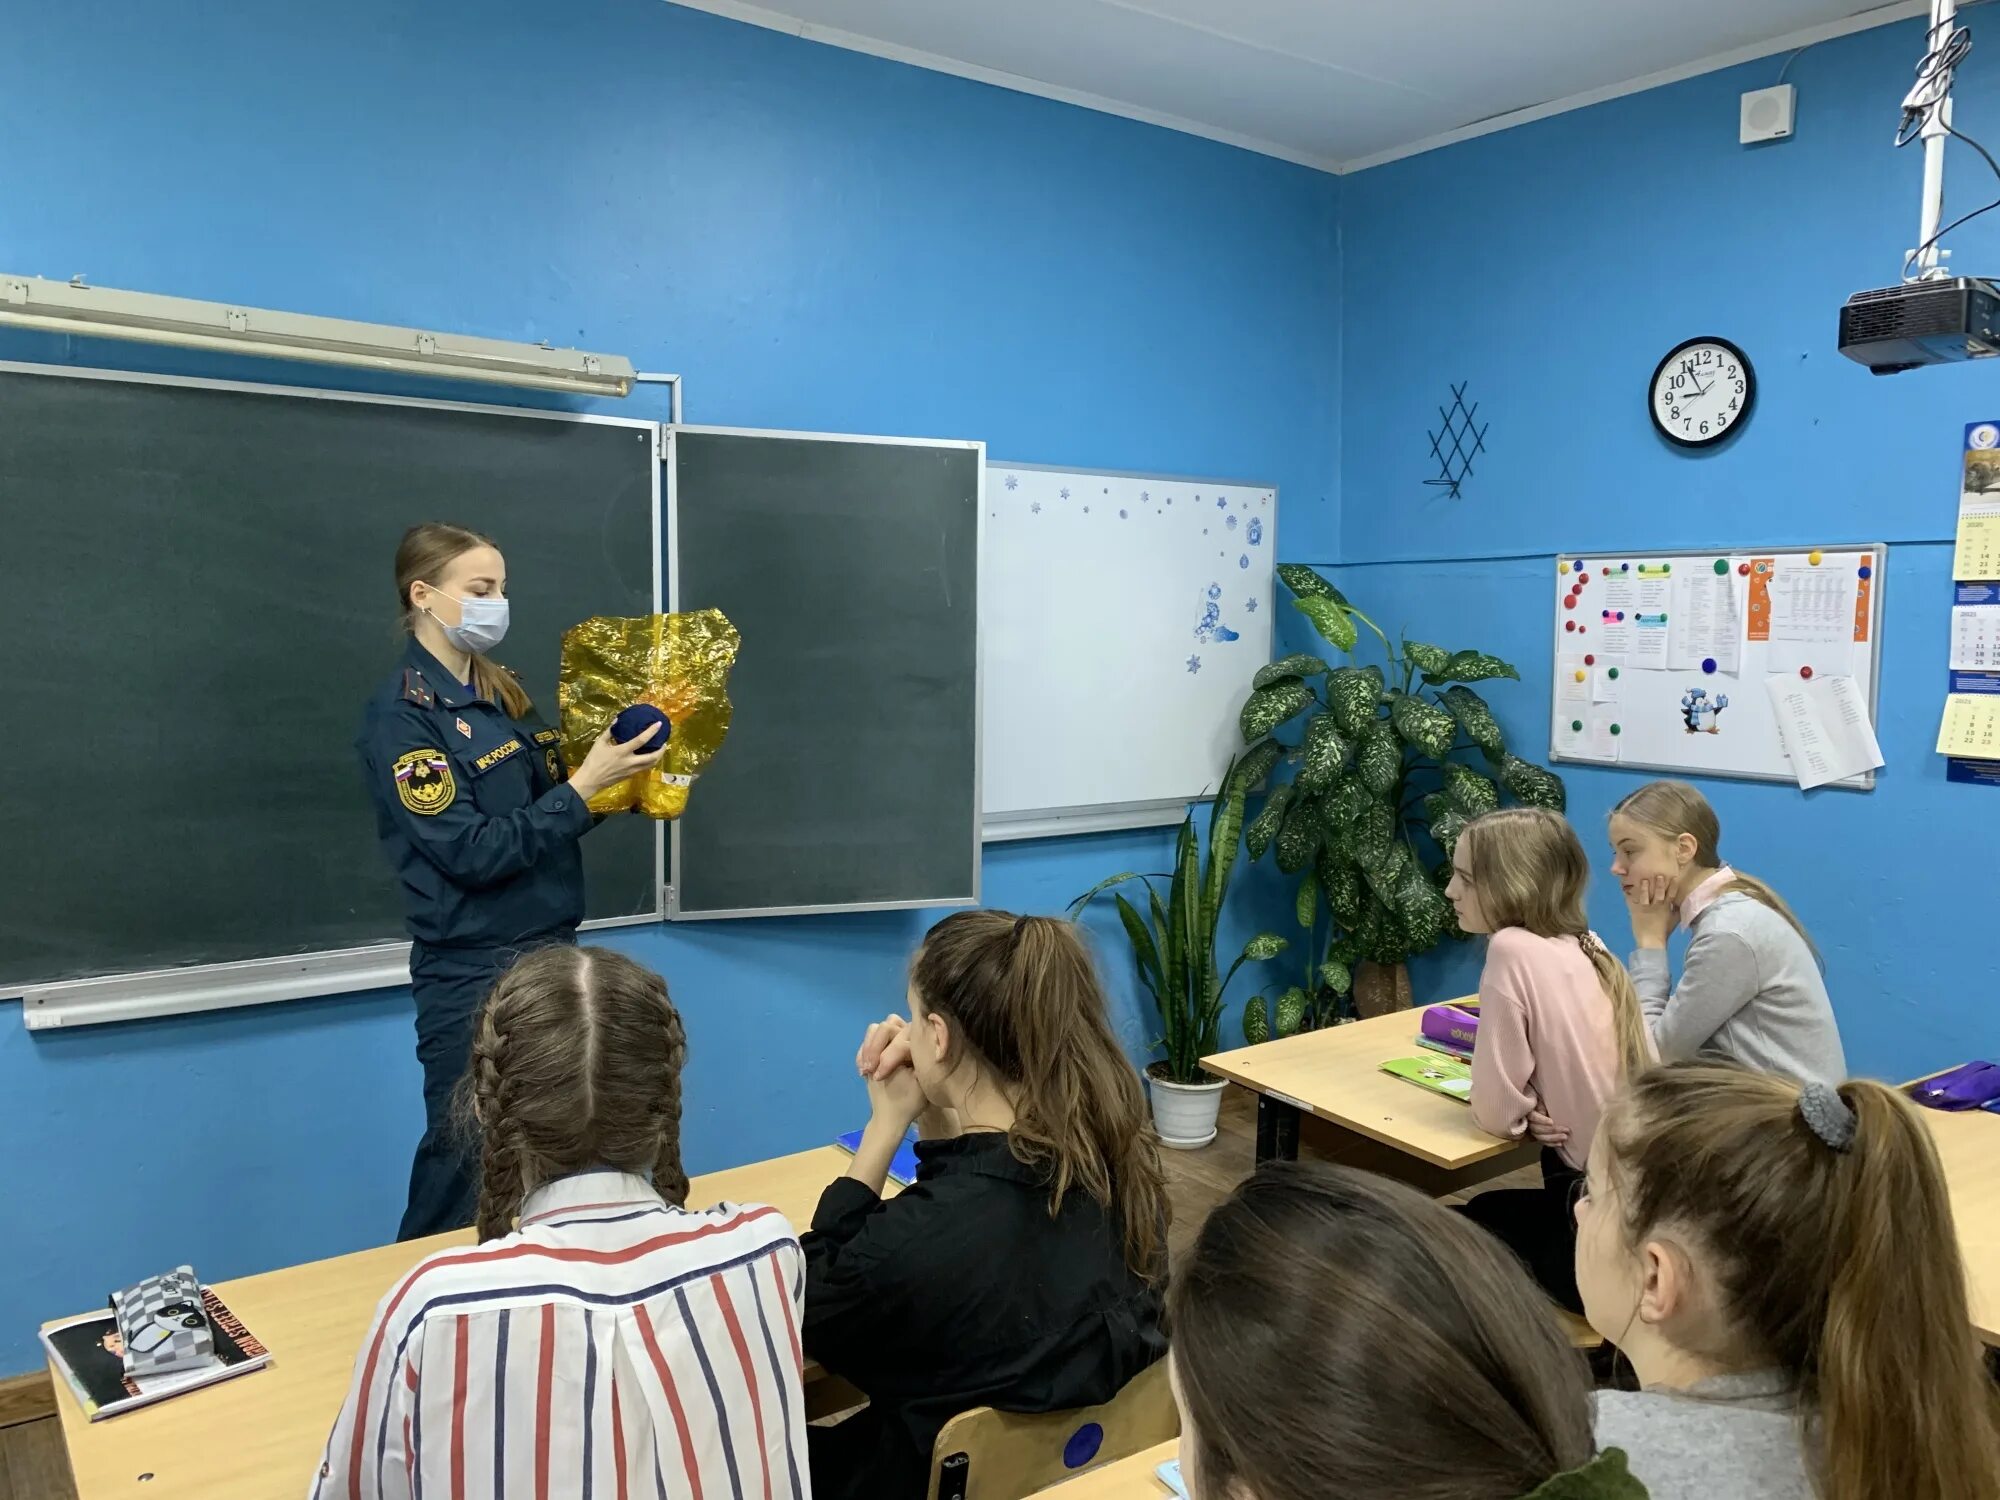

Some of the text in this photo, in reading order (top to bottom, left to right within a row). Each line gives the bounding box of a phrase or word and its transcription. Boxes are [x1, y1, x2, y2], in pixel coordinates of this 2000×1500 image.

[1694, 350, 1712, 366] 12
[1716, 354, 1724, 368] 1
[1680, 358, 1696, 374] 11
[1728, 364, 1736, 380] 2
[1669, 374, 1685, 390] 10
[1735, 380, 1744, 394] 3
[1664, 392, 1674, 406] 9
[1728, 396, 1738, 410] 4
[1671, 406, 1680, 420] 8
[1718, 412, 1726, 426] 5
[1683, 417, 1692, 432] 7
[1700, 420, 1708, 434] 6
[476, 740, 522, 770] МЧС РОССИИ
[211, 1311, 248, 1338] STREET
